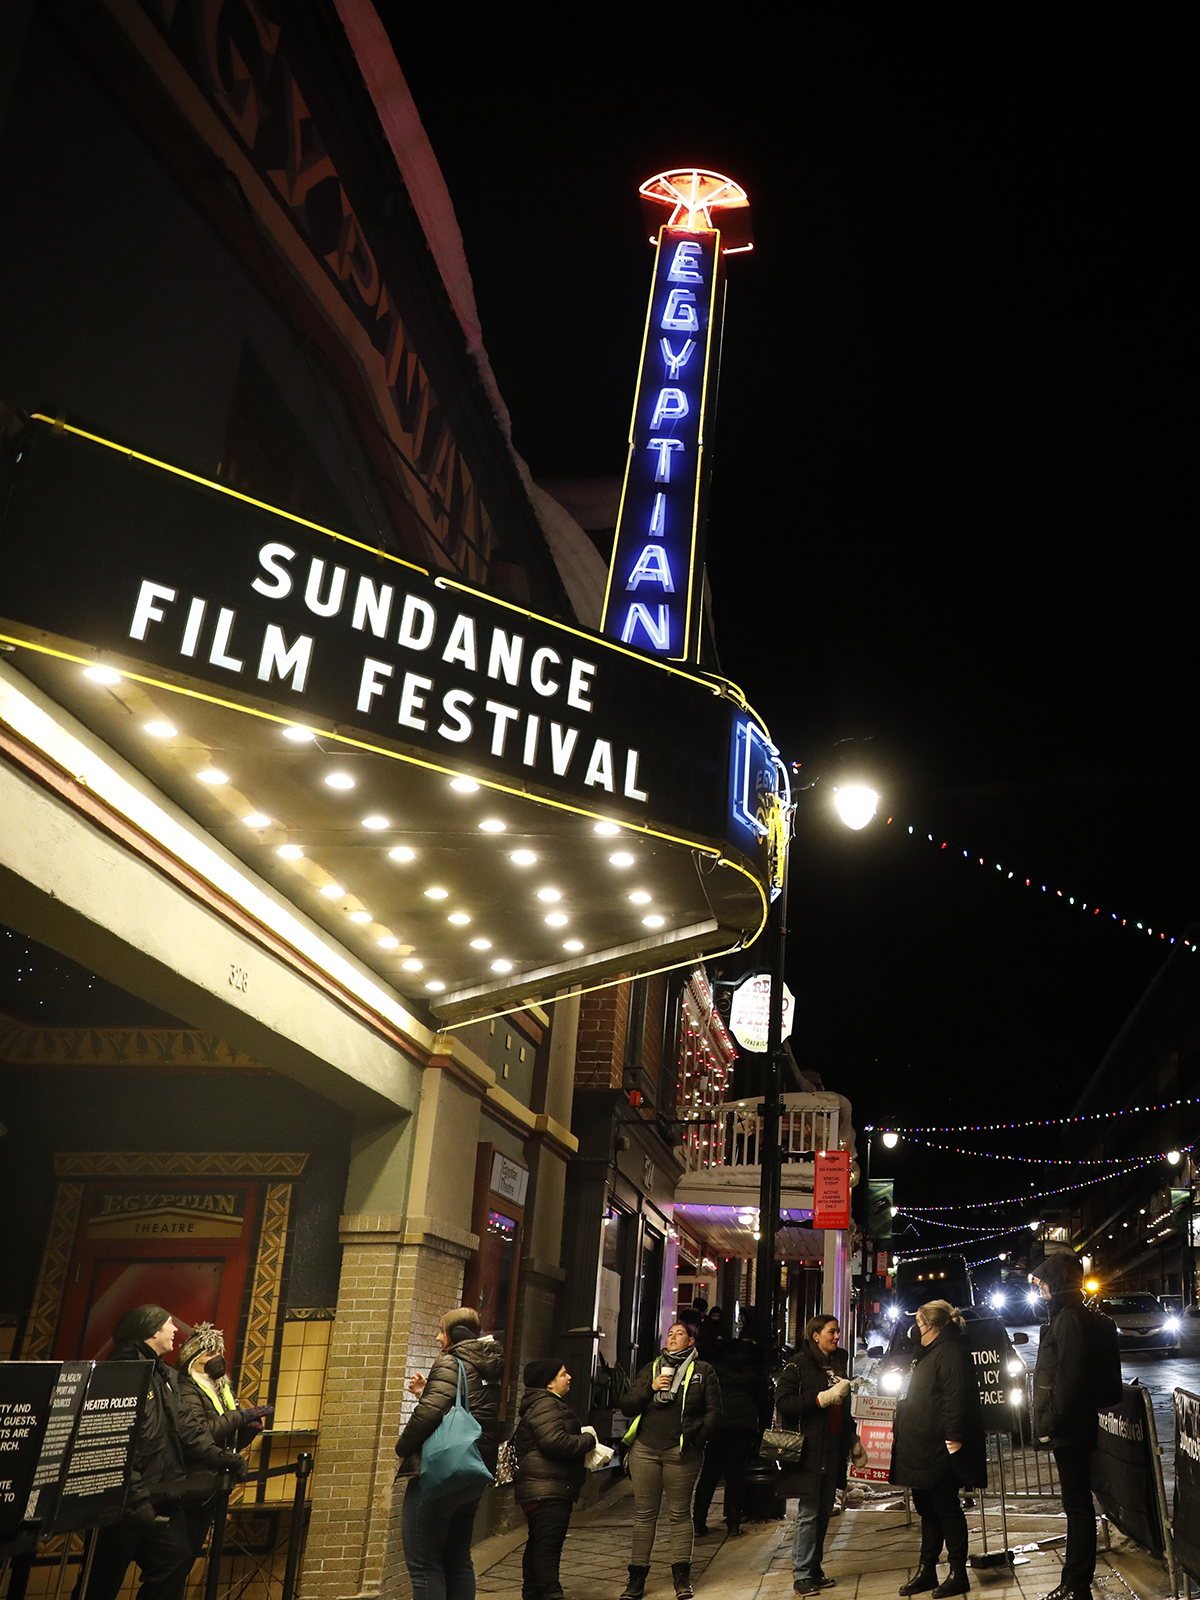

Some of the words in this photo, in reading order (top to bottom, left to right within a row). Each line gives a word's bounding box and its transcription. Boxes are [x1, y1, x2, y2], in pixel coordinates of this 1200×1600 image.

[160, 0, 495, 580] GYPTIAN
[623, 240, 704, 650] EGYPTIAN
[251, 540, 598, 713] SUNDANCE
[128, 578, 315, 693] FILM
[356, 656, 649, 802] FESTIVAL
[228, 964, 248, 993] 328
[502, 1161, 518, 1182] Egyptian
[500, 1177, 516, 1197] Theatre
[101, 1194, 238, 1215] EGYPTIAN
[135, 1223, 195, 1234] THEATRE
[983, 1369, 1000, 1385] ICY
[84, 1399, 109, 1411] HEATER
[110, 1396, 138, 1410] POLICIES
[862, 1398, 874, 1406] NO
[979, 1390, 1005, 1405] FACE
[13, 1403, 32, 1413] AND
[4, 1416, 38, 1427] GUESTS,
[12, 1428, 31, 1438] ARE
[0, 1441, 20, 1451] RCH.
[4, 1492, 16, 1503] TO
